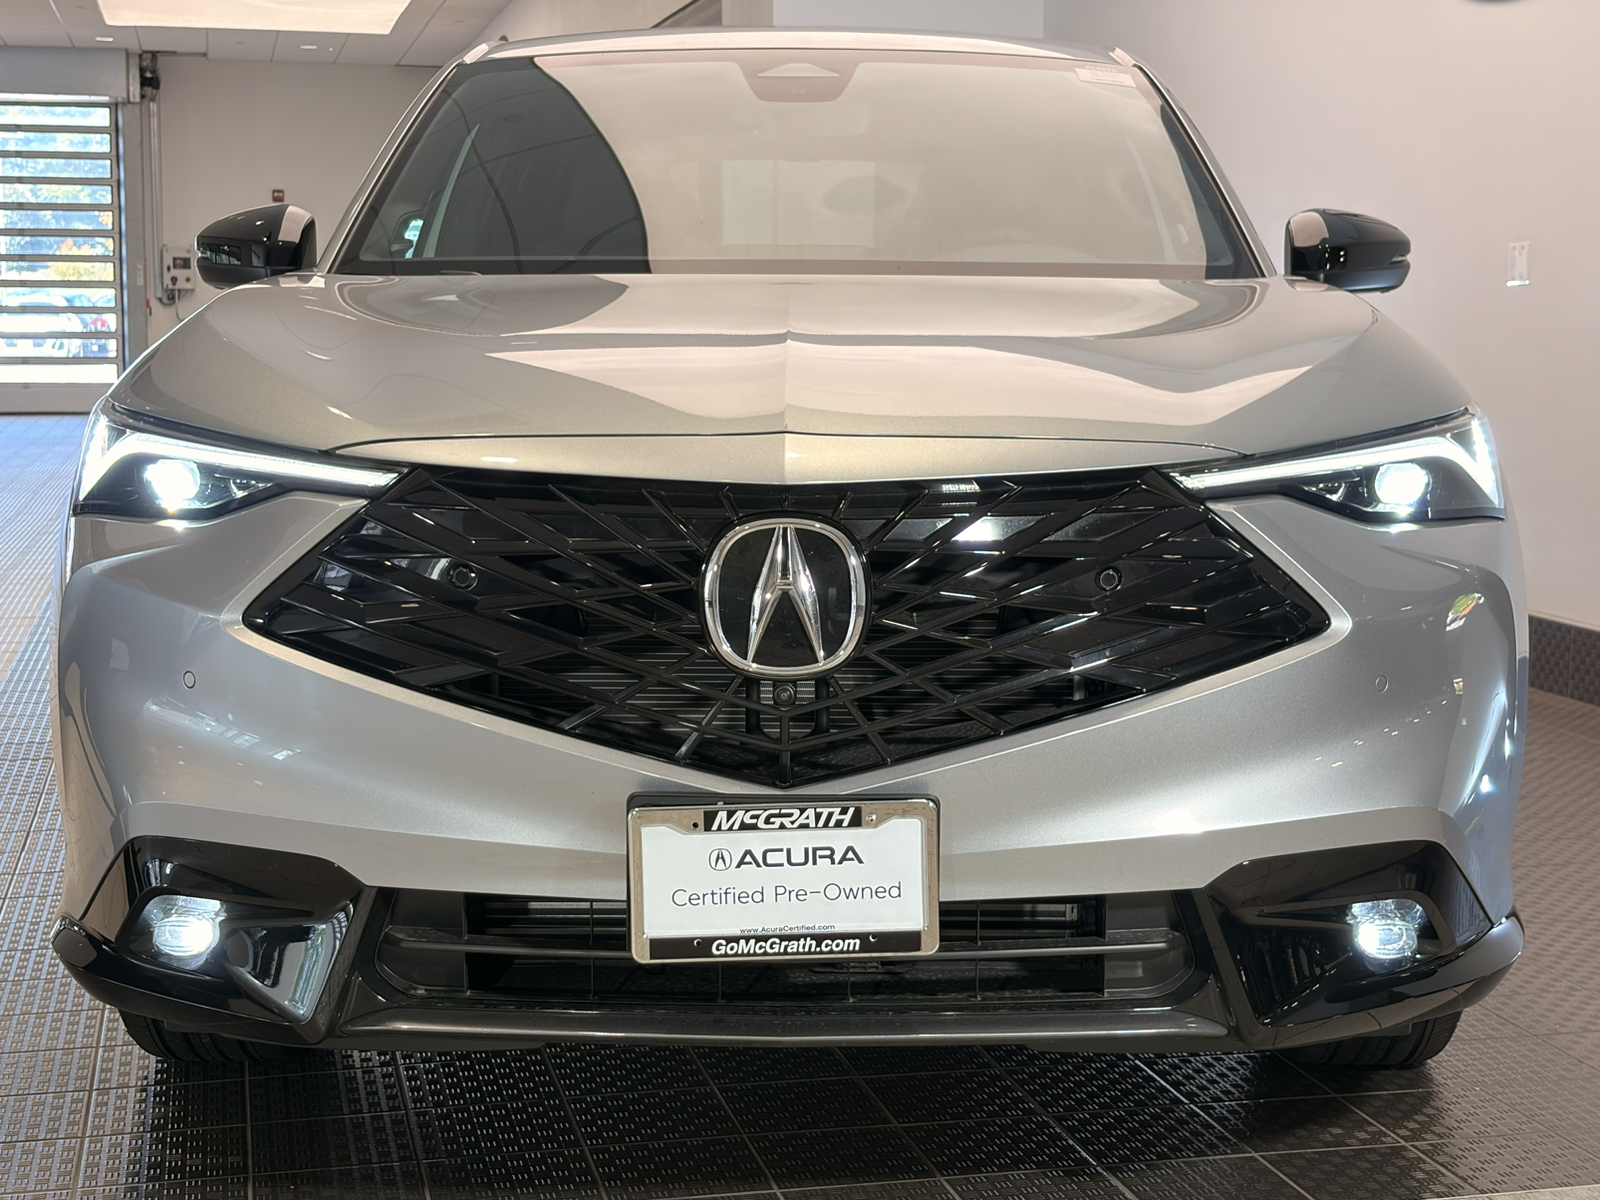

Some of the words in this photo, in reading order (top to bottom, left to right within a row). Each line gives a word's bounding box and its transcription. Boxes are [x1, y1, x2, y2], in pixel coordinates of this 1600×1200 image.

[711, 807, 855, 831] McGRATH
[735, 845, 865, 869] ACURA
[671, 886, 765, 907] Certified
[774, 880, 901, 902] Pre-Owned
[739, 924, 836, 934] www.AcuraCertified.com
[711, 937, 861, 955] GoMcGrath.com
